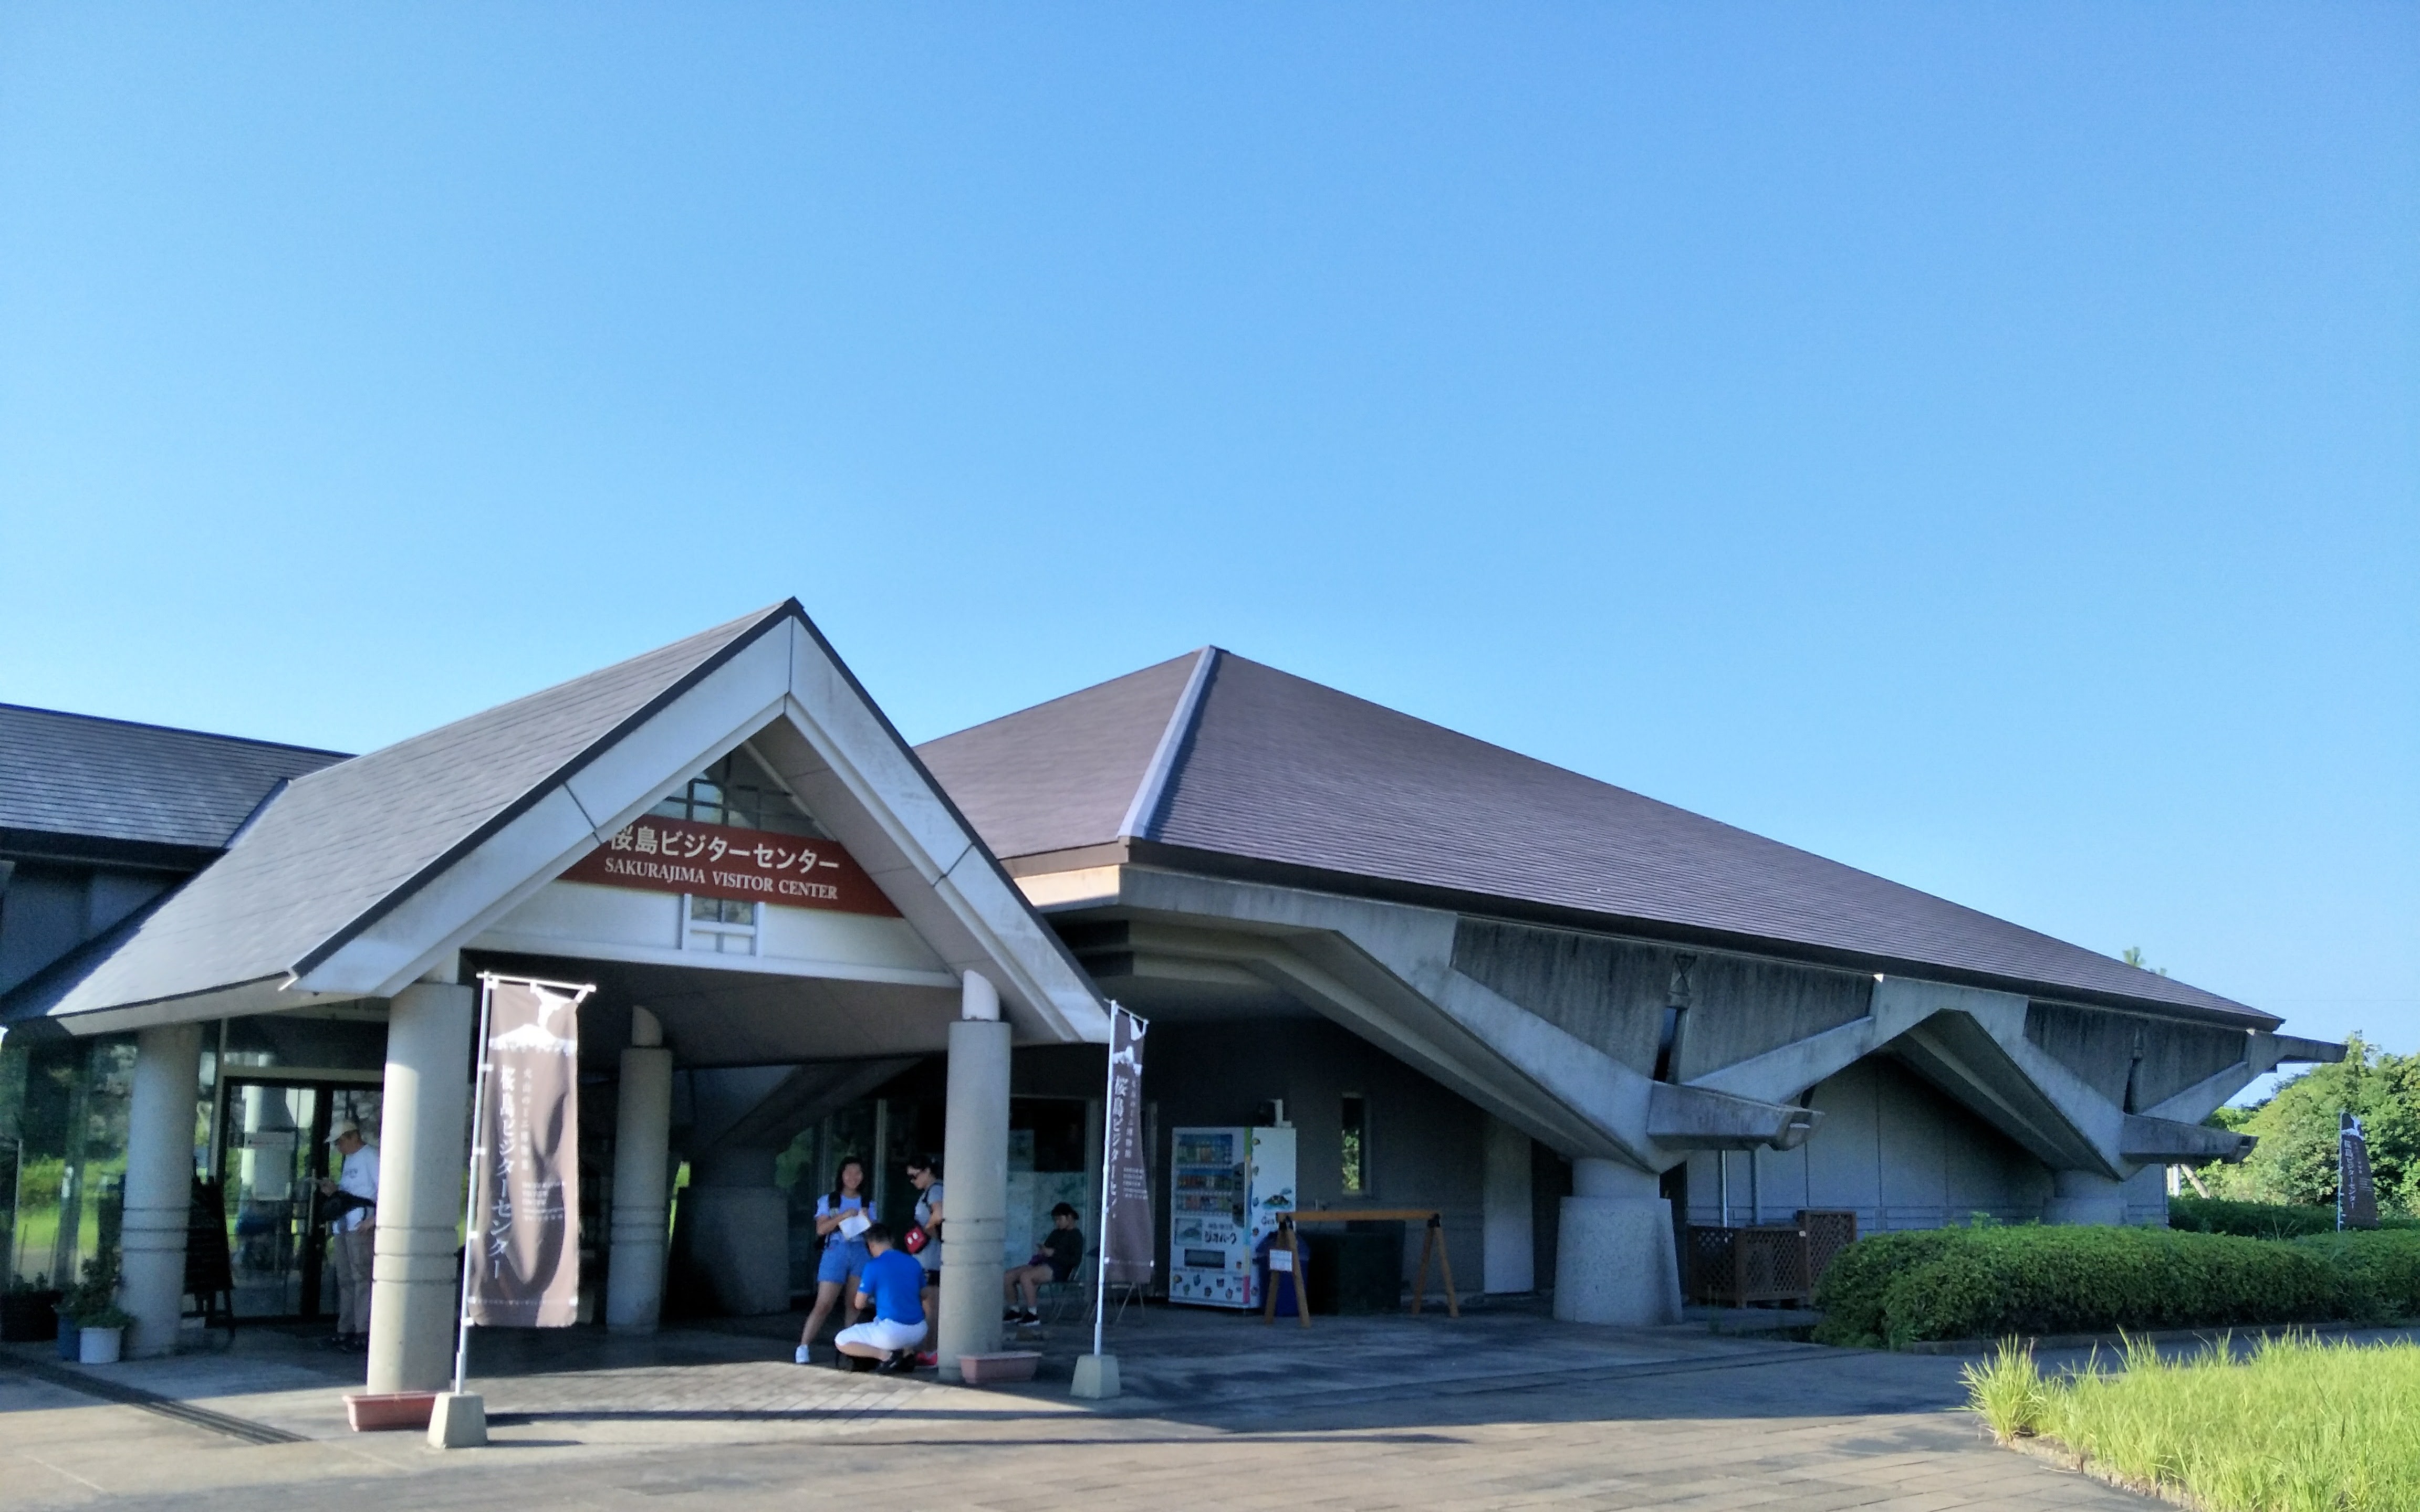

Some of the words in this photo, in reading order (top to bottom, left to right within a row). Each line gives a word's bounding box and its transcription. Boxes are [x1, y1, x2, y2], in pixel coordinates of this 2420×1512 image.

[604, 857, 706, 884] SAKURAJIMA
[712, 870, 774, 892] VISITOR
[778, 879, 838, 899] CENTER
